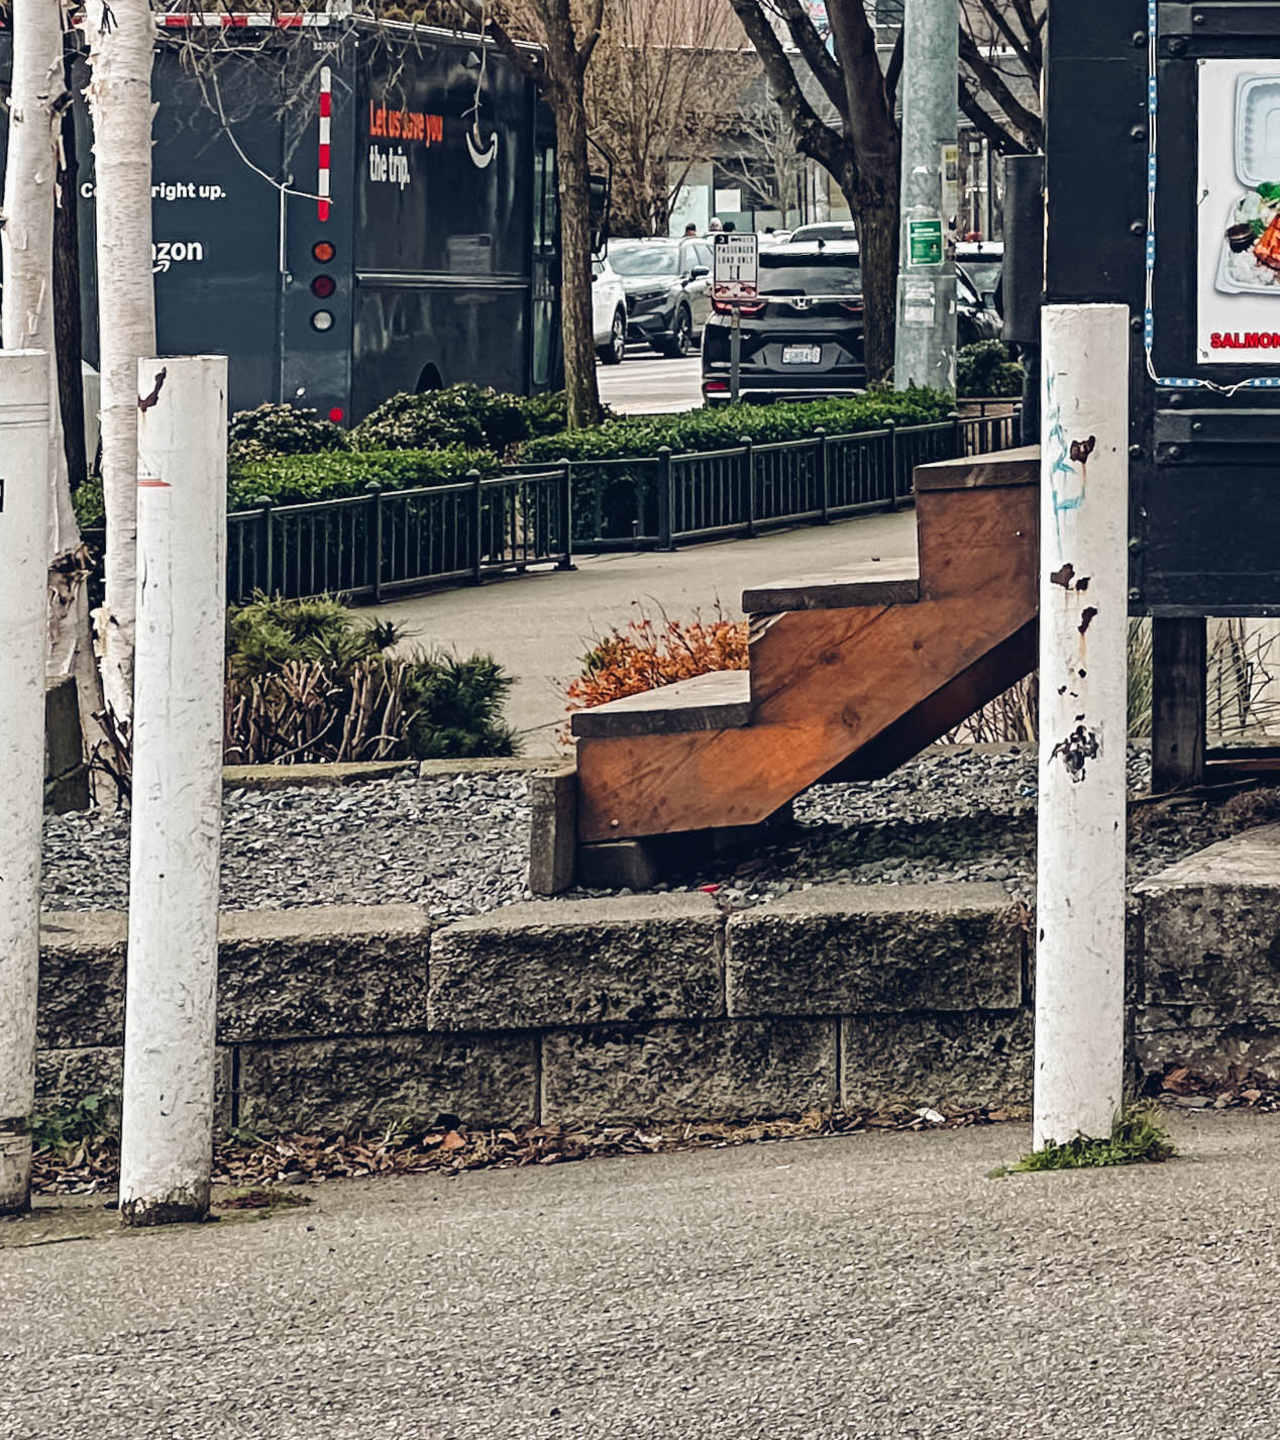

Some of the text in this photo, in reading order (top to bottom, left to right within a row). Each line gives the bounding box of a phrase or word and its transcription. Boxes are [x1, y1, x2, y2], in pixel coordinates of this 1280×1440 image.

[370, 99, 387, 137] Let
[388, 109, 401, 138] us
[425, 113, 443, 148] you
[370, 145, 411, 191] the trip.
[151, 182, 226, 201] right up.
[151, 241, 203, 260] zon
